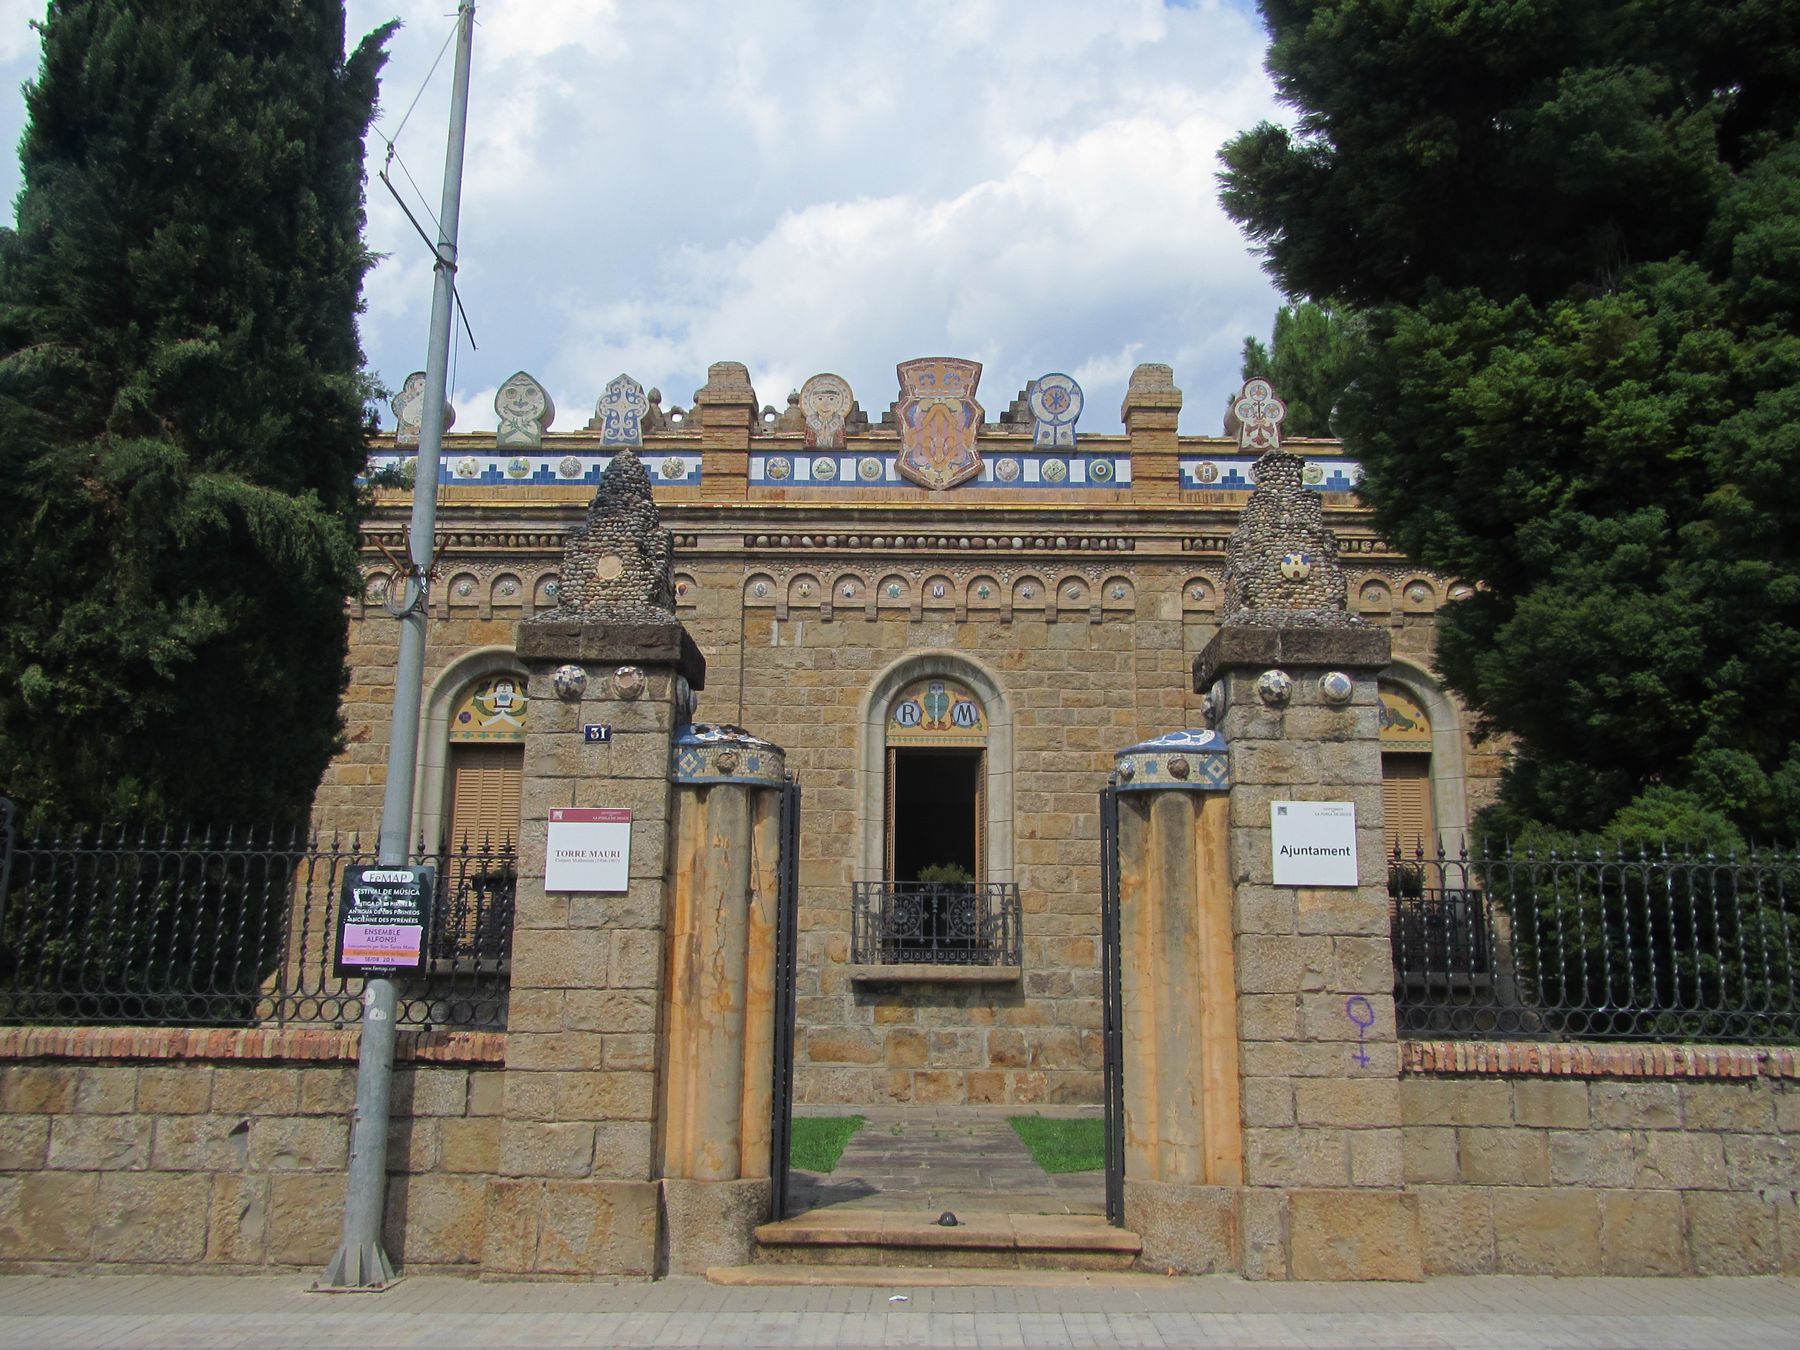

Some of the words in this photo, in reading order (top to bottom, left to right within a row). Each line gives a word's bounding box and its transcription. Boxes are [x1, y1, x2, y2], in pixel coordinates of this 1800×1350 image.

[933, 586, 944, 596] M
[902, 704, 915, 723] R
[956, 704, 973, 723] M
[590, 727, 606, 740] 31
[555, 850, 587, 858] TORRE
[589, 850, 621, 858] MAURI
[1280, 845, 1351, 857] Ajuntament
[393, 887, 420, 896] MÚSICA
[364, 928, 401, 936] ENSEMBLE
